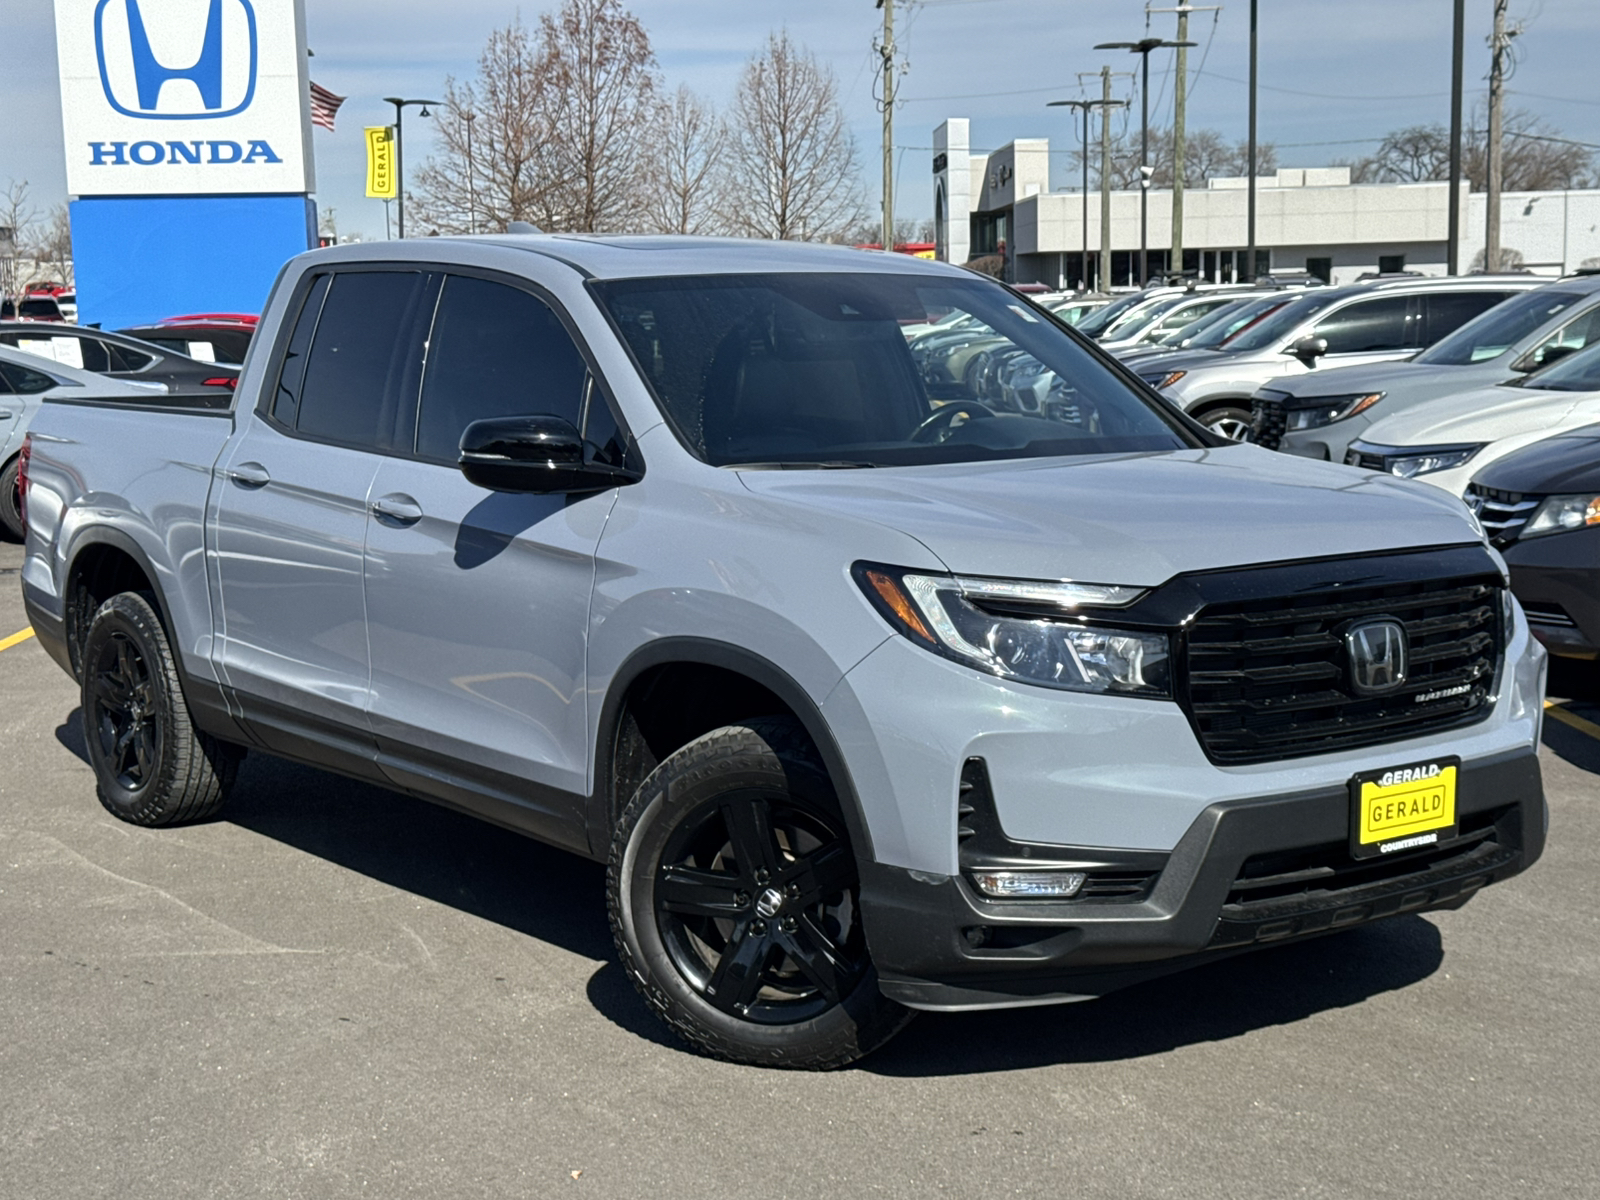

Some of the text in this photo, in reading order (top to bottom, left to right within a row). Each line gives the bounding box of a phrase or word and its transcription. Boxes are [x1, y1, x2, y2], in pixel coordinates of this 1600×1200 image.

[87, 140, 284, 166] HONDA
[376, 135, 387, 188] GERALD
[1381, 763, 1440, 787] GERALD
[1372, 794, 1441, 822] GERALD
